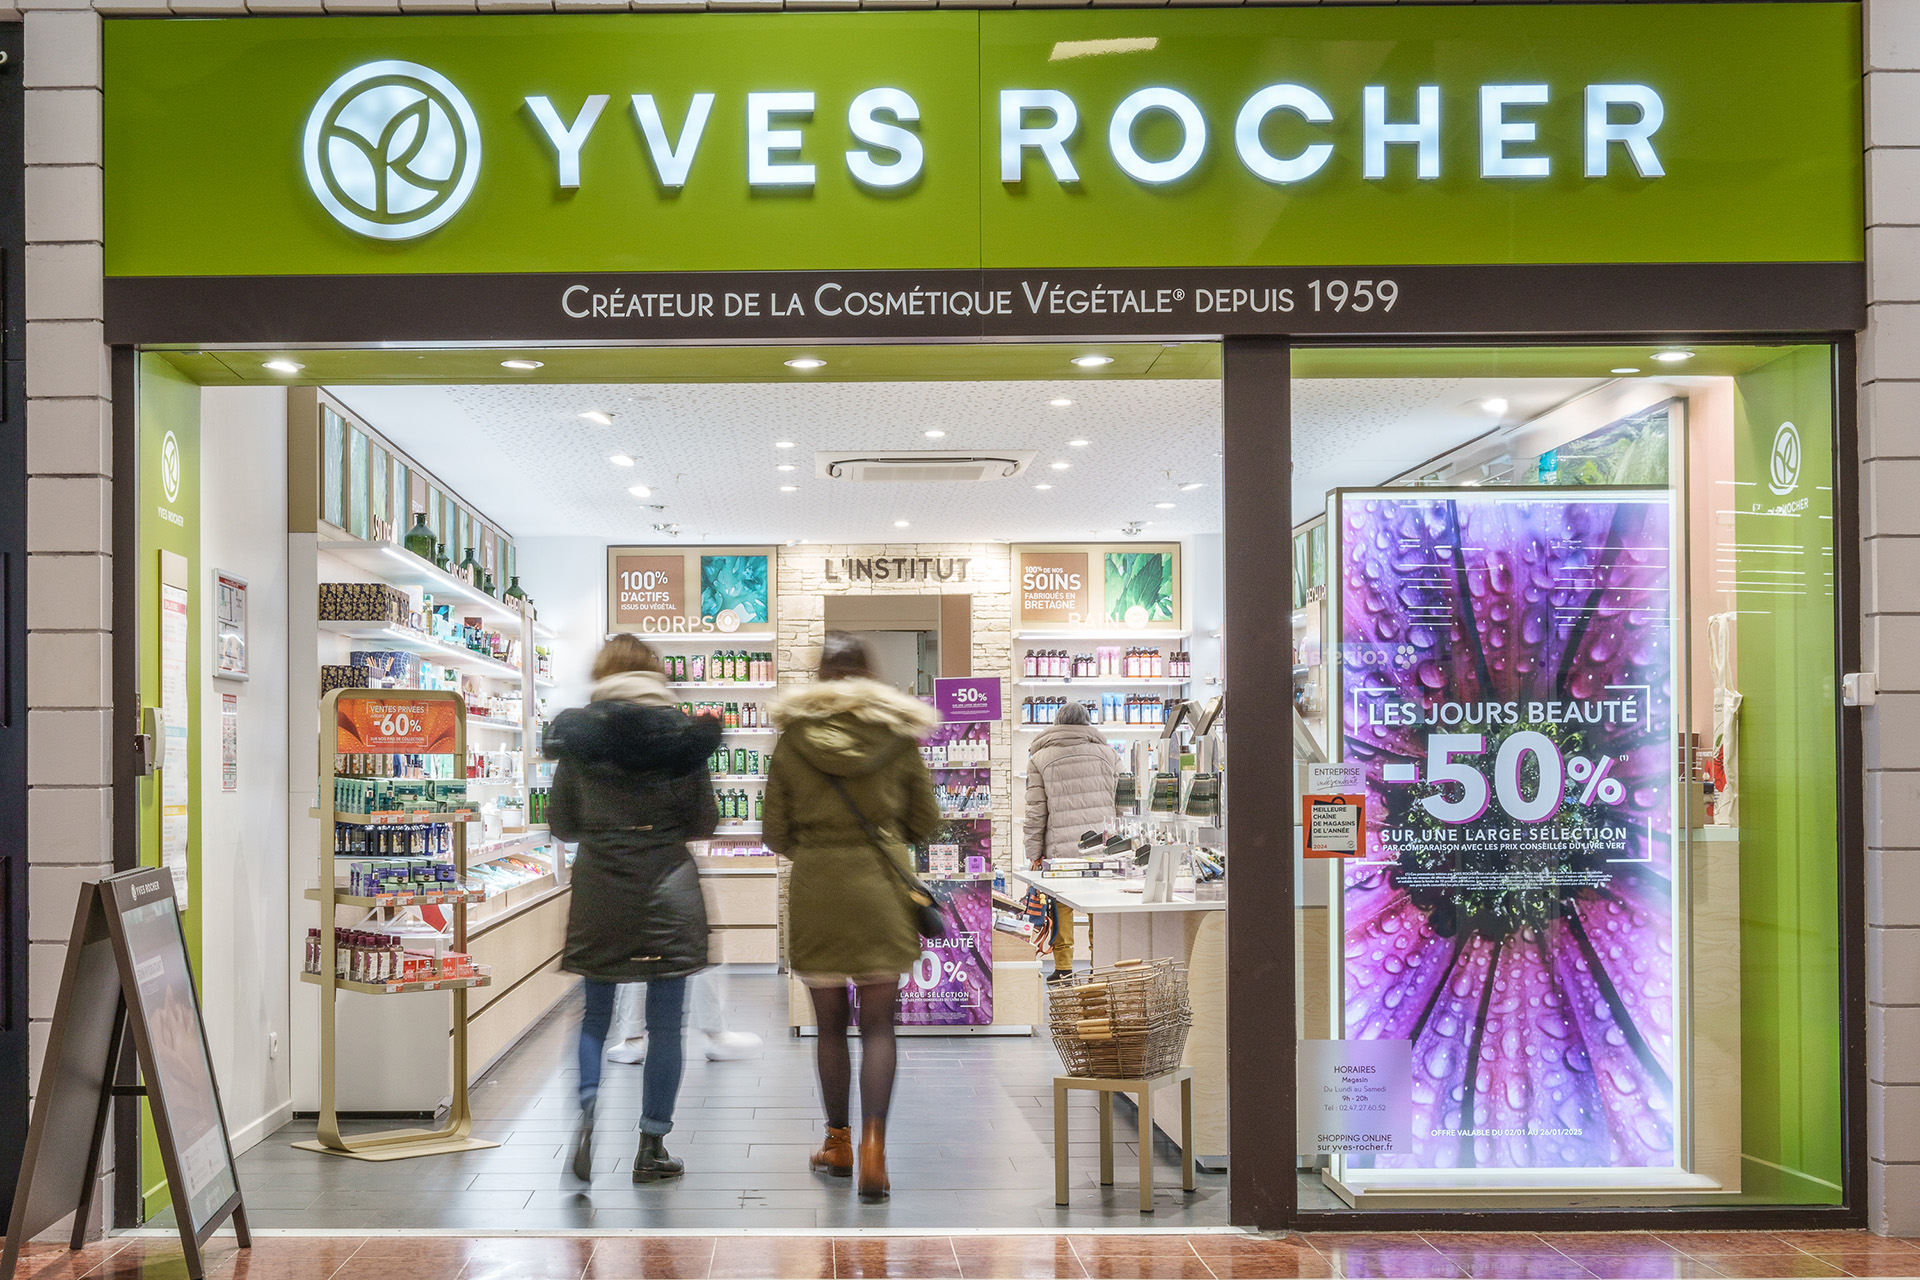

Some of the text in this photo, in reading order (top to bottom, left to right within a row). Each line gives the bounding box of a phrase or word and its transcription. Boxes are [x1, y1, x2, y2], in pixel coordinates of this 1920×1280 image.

[524, 83, 1667, 190] YVES ROCHER
[725, 293, 760, 317] DE
[771, 293, 805, 316] LA
[1196, 289, 1295, 313] DEPUIS
[1308, 279, 1399, 313] 1959
[158, 506, 184, 527] YVES ROCHER
[825, 558, 971, 580] L'INSTITUT
[1025, 566, 1042, 574] 100%
[620, 570, 668, 590] 100%
[1023, 573, 1081, 591] SOINS
[621, 591, 670, 602] D'ACTIFS
[1025, 591, 1076, 600] FABRIQUÉS EN
[621, 602, 676, 611] ISSUS DU VÉGÉTAL
[1025, 600, 1076, 610] BRETAGNE
[642, 615, 715, 633] CORPS
[951, 688, 987, 703] -50%
[370, 705, 425, 713] VENTES PRIVÉES
[1369, 695, 1638, 725] LES JOURS BEAUTÉ
[373, 714, 422, 736] -60%
[1314, 768, 1360, 776] ENTREPRISE
[1383, 731, 1625, 822] -50%
[1381, 826, 1627, 842] SUR UNE LARGE SÉLECTION
[1461, 843, 1483, 851] AVEC
[136, 881, 160, 896] YVES ROCHER
[927, 936, 974, 948] BEAUTÉ
[898, 951, 967, 990] 0%
[1334, 1066, 1376, 1074] HORAIRES
[1317, 1134, 1392, 1142] SHOPPING ONLINE
[1457, 1129, 1490, 1137] VALABLE
[1540, 1128, 1583, 1136] 26/01/2025
[1332, 1143, 1393, 1152] yves-rocher.fr
